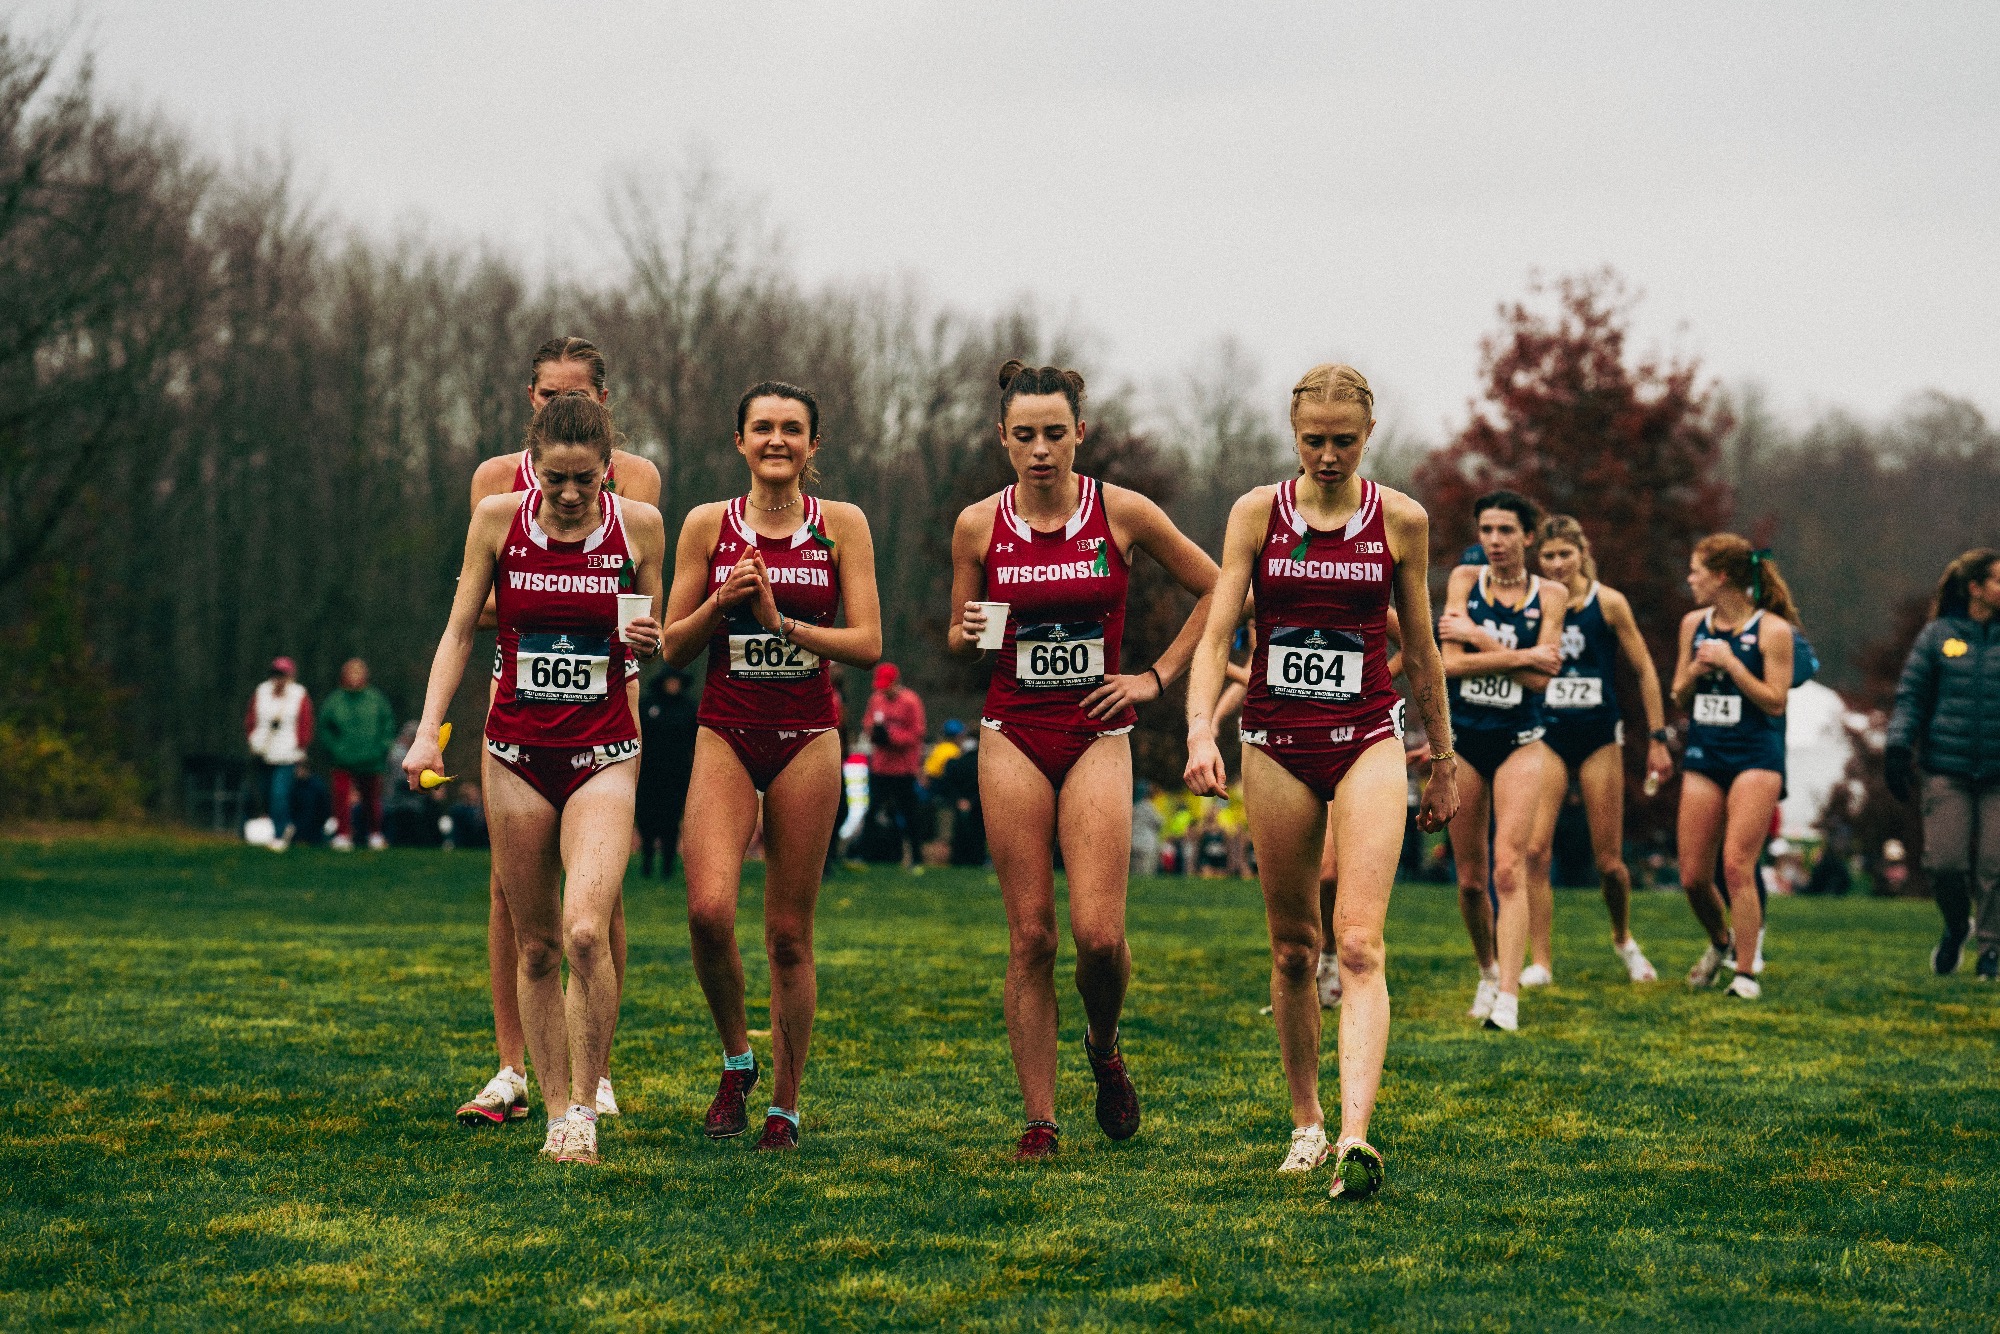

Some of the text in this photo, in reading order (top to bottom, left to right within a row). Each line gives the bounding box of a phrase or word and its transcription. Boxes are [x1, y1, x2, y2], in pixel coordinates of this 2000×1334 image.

[508, 570, 619, 594] WISCONSIN
[715, 565, 829, 587] WONSIN
[1268, 558, 1383, 582] WISCONSIN
[744, 638, 804, 667] 662
[1030, 643, 1089, 676] 660
[531, 656, 592, 690] 665
[1282, 651, 1346, 688] 664
[1470, 676, 1512, 698] 580
[1555, 682, 1592, 700] 572
